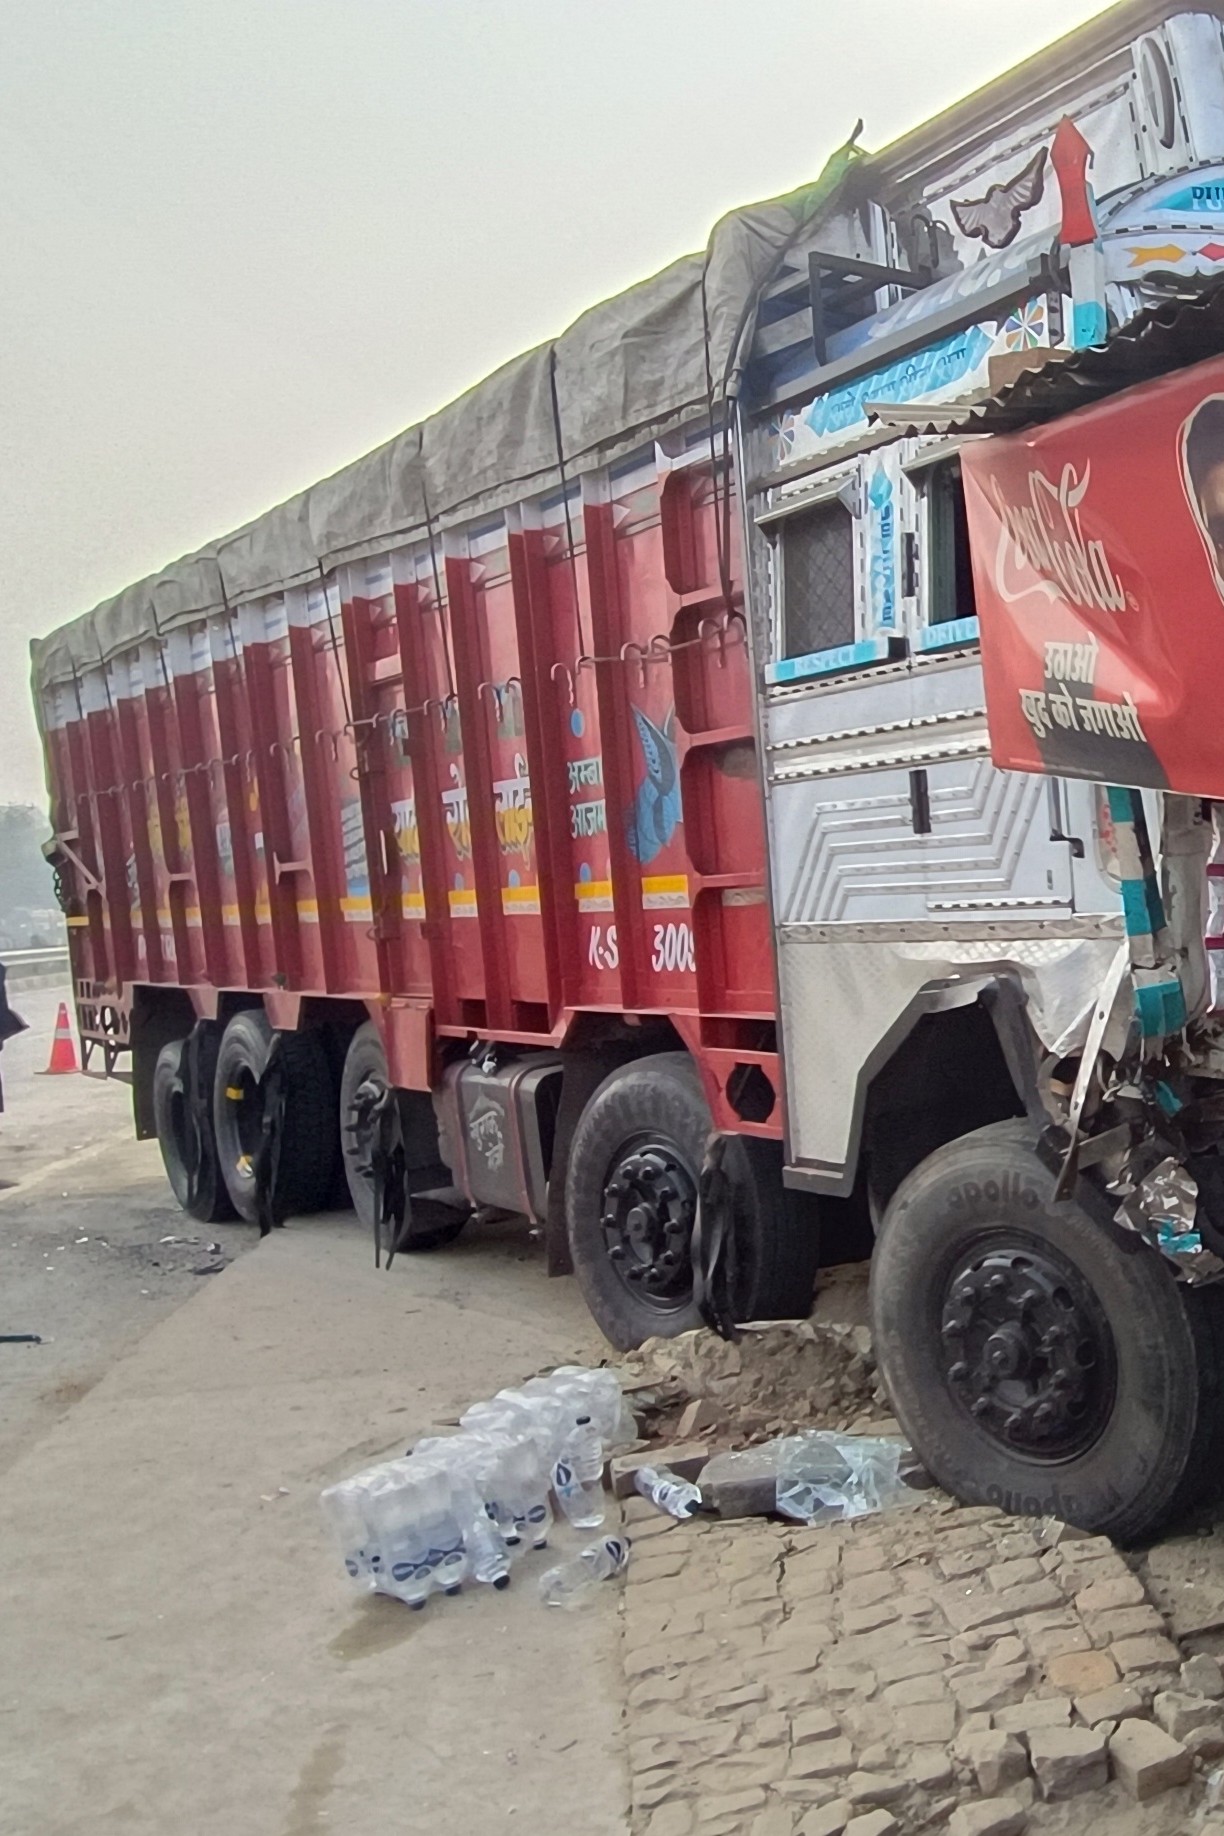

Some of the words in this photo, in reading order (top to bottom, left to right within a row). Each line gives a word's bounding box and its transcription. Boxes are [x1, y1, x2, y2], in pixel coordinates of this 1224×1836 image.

[1044, 630, 1099, 685] उठाओ
[1048, 682, 1080, 731] को
[1075, 691, 1148, 742] जगाओ
